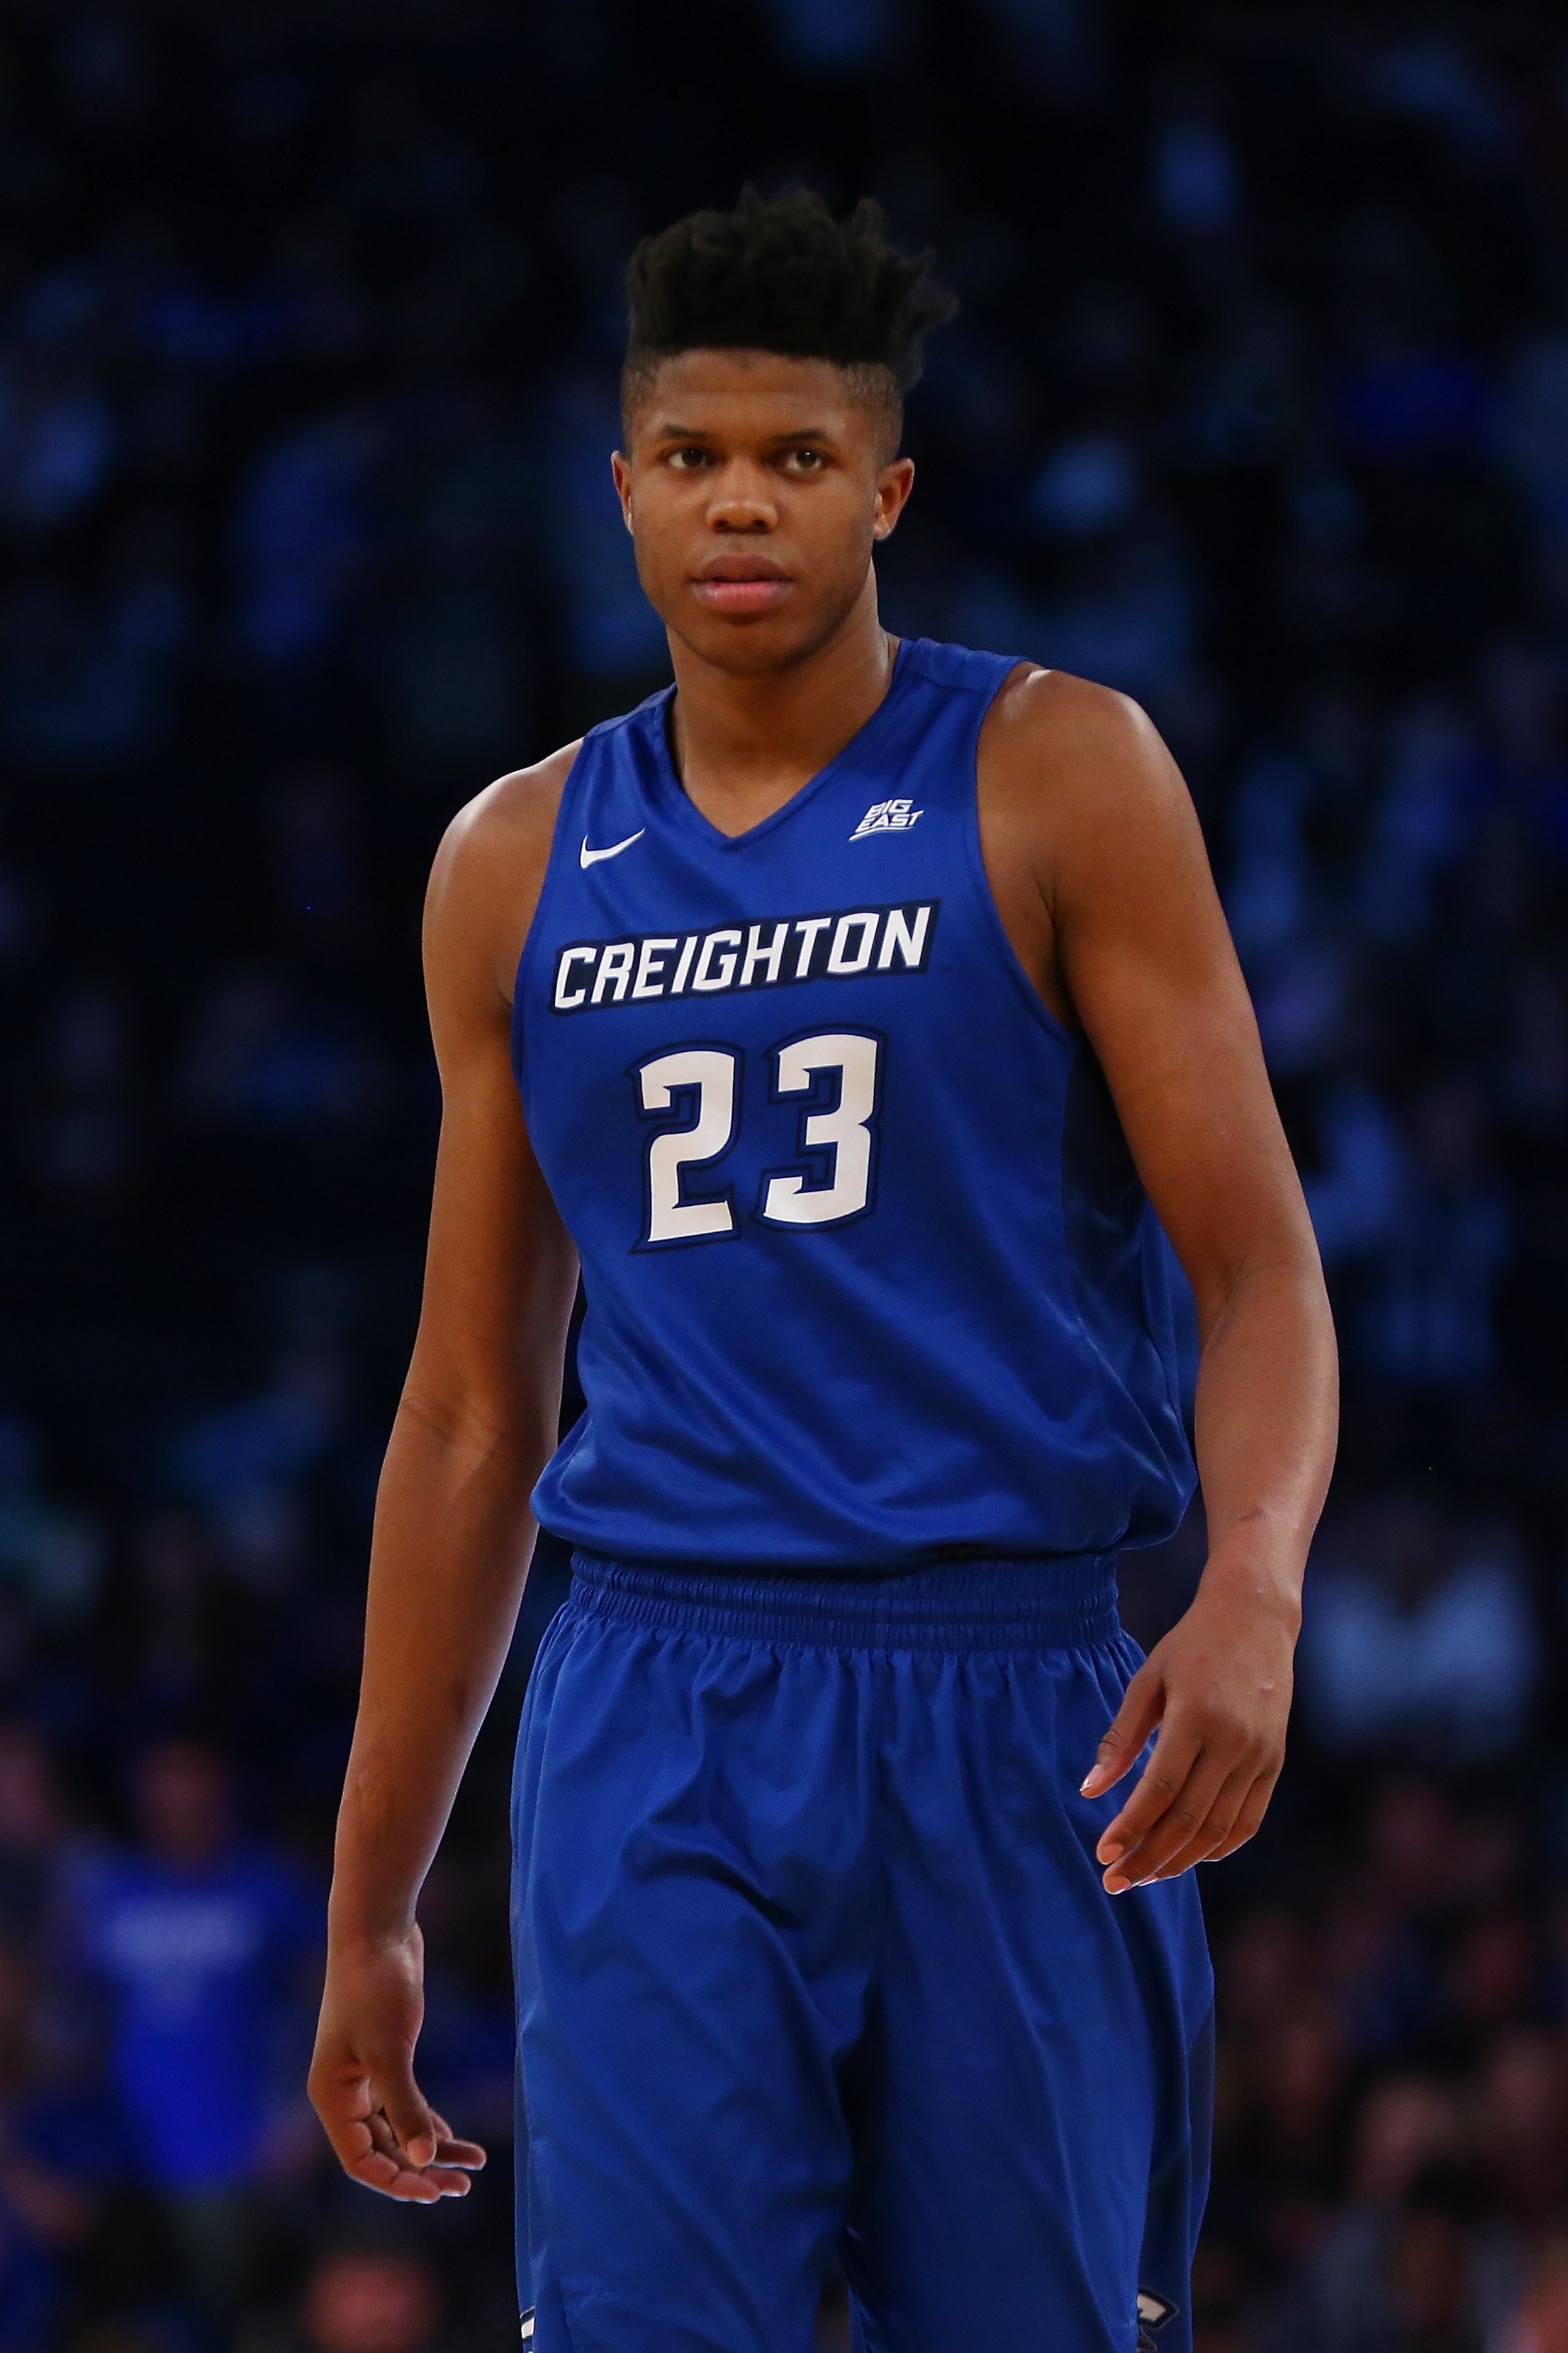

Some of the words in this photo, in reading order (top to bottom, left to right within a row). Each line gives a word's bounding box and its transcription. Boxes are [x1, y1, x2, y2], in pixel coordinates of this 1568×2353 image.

[854, 809, 925, 833] EAST
[863, 798, 914, 819] BIG
[554, 905, 931, 1009] CREIGHTON
[639, 1033, 878, 1243] 23
